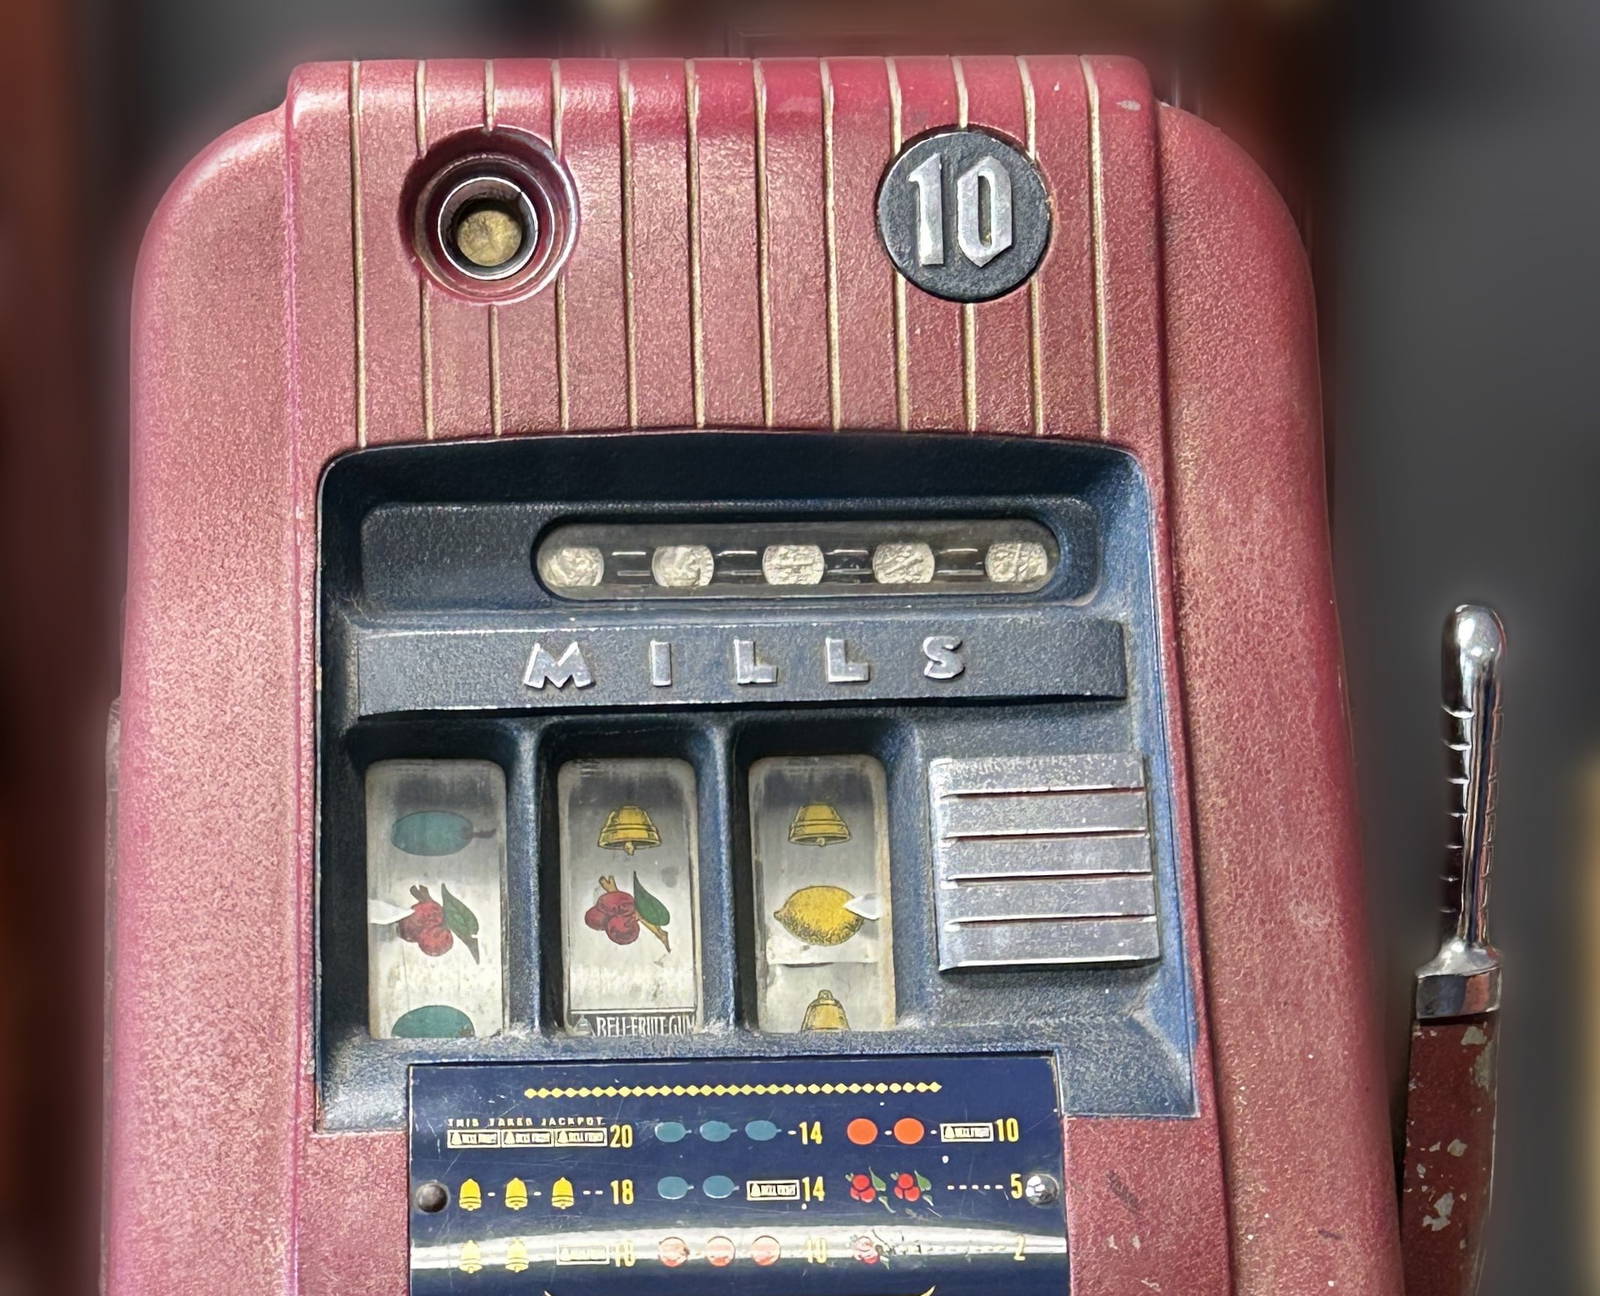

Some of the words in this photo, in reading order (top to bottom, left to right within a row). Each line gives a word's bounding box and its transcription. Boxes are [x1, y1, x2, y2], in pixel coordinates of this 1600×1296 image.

[908, 153, 1013, 268] 10
[523, 636, 966, 691] MILLS
[541, 1116, 604, 1126] JACKPOT
[798, 1120, 823, 1145] 14
[995, 1117, 1020, 1142] 10
[609, 1124, 634, 1148] 20
[610, 1178, 635, 1205] 18
[801, 1175, 825, 1202] 14
[1010, 1173, 1023, 1199] 5
[1013, 1234, 1026, 1261] 2
